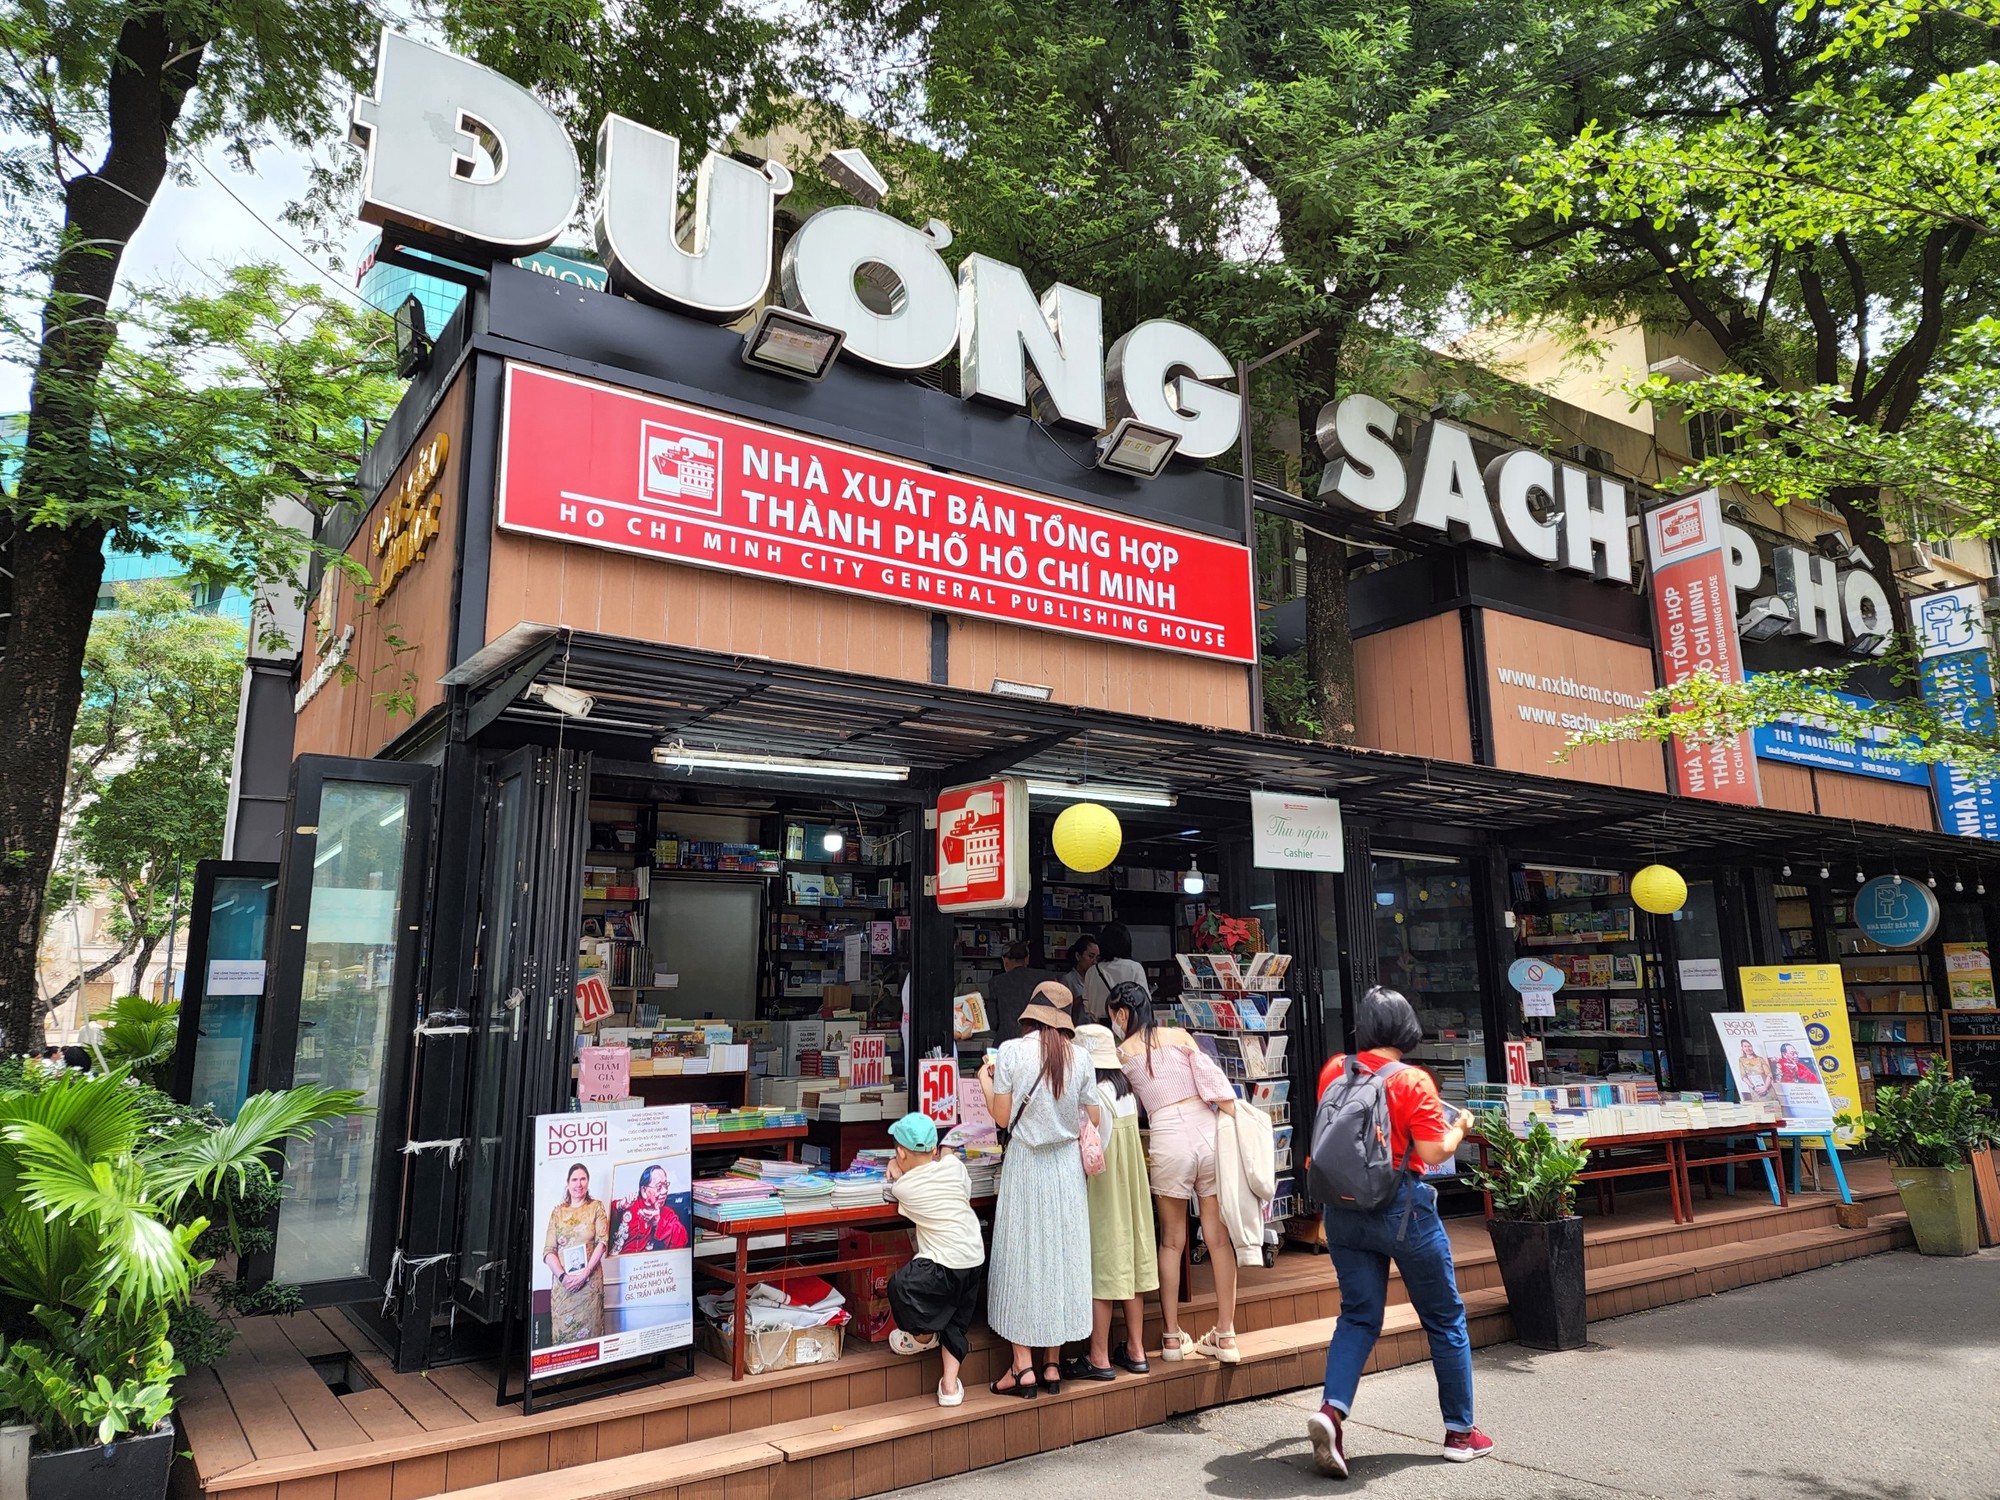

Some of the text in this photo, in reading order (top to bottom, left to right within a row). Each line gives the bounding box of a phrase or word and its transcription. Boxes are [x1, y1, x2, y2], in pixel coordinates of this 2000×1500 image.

[352, 26, 1243, 460] ĐƯỜNG
[742, 443, 1179, 574] NHÀ XUẤT BẢN TỔNG HỢP
[742, 489, 1176, 611] THÀNH PHỐ HỒ CHÍ MINH
[560, 502, 1226, 648] HO CHI MINH CITY GENERAL PUBLISHING HOUSE
[1709, 574, 1720, 606] HOUSE
[1664, 586, 1684, 621] HỢP
[1688, 580, 1708, 625] MINH
[1666, 622, 1689, 670] TỔNG
[1690, 625, 1712, 656] CHÍ
[1713, 607, 1729, 661] PUBLISHING
[1684, 756, 1706, 793] NHÀ
[1707, 738, 1730, 790] THÀN
[1732, 749, 1744, 768] CHI
[1735, 769, 1746, 785] HO
[1266, 814, 1294, 838] Thu
[1283, 847, 1314, 859] Cashier
[576, 980, 609, 1021] 20
[853, 1037, 884, 1059] SÁCH
[1508, 1045, 1528, 1086] 50
[598, 1071, 615, 1081] GIÁ
[853, 1059, 884, 1087] MỚI
[923, 1064, 954, 1121] 50
